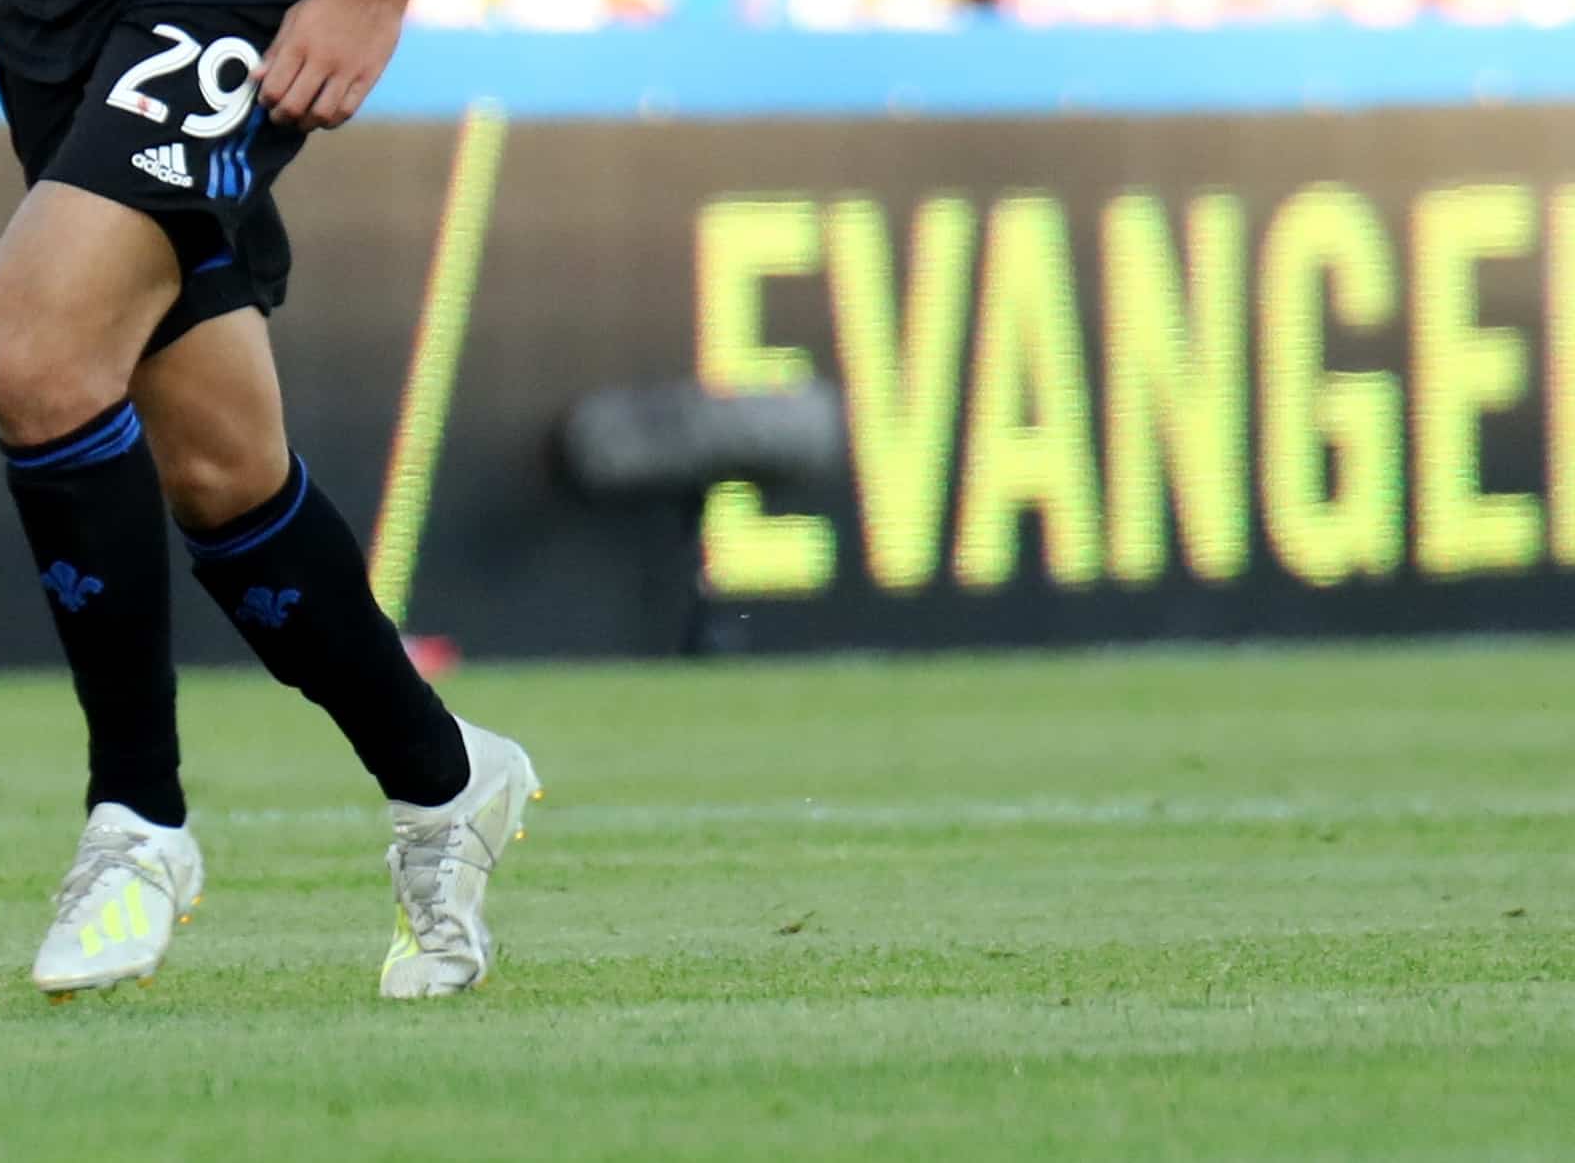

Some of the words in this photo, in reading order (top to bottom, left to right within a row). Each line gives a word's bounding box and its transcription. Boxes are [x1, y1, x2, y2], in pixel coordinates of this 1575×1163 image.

[105, 23, 262, 138] 29
[131, 152, 194, 188] adidas
[694, 181, 1575, 600] EVANGE
